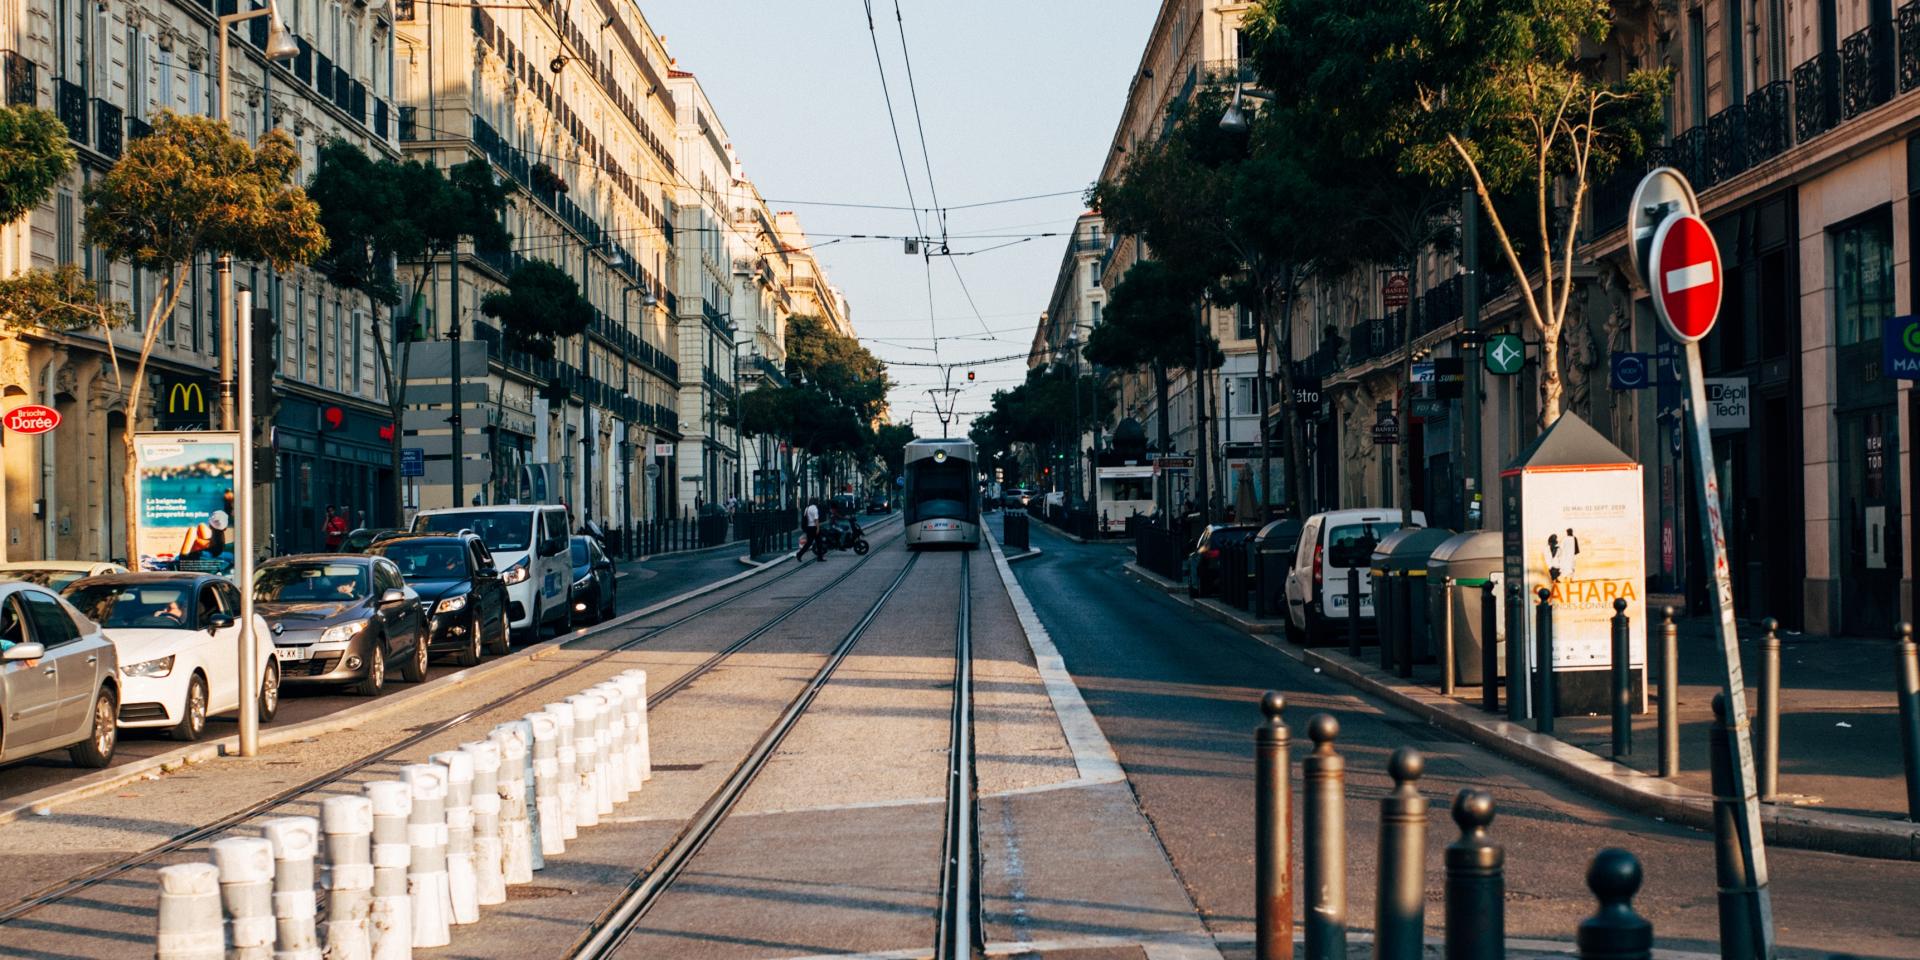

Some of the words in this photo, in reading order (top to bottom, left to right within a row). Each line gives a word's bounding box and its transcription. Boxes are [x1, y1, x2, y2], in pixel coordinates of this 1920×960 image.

[1292, 388, 1319, 403] étro
[1711, 385, 1747, 404] Dépil
[1712, 403, 1746, 416] Tech
[11, 416, 53, 430] Dorée
